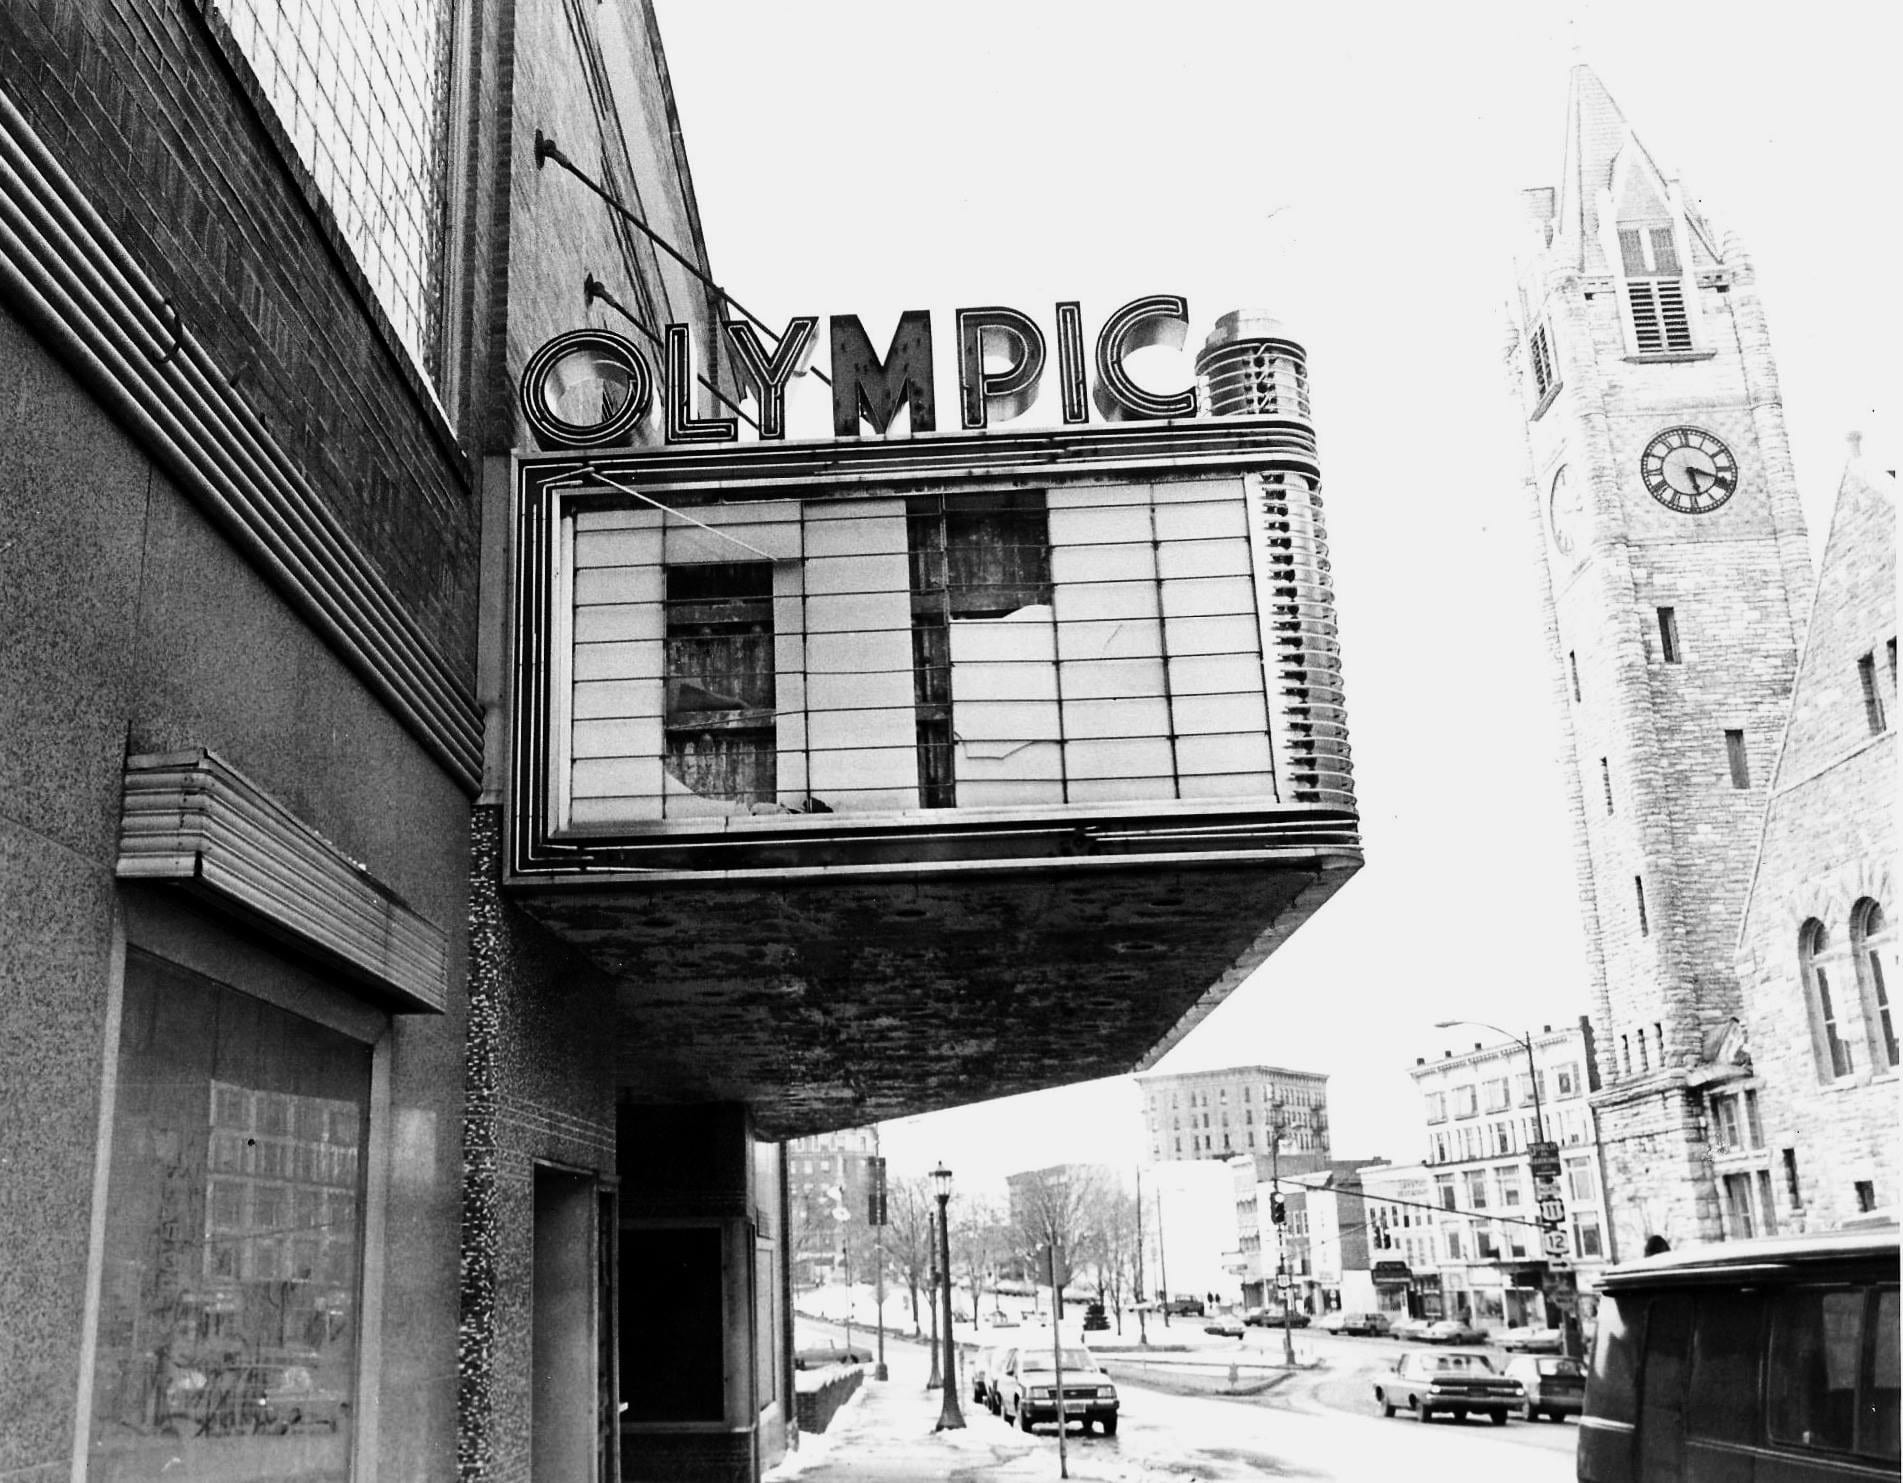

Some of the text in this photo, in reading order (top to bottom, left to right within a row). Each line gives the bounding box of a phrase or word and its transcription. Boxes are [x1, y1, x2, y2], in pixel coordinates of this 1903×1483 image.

[520, 295, 1197, 448] OLYMPIC
[1547, 1204, 1558, 1217] 11
[1549, 1235, 1565, 1248] 12
